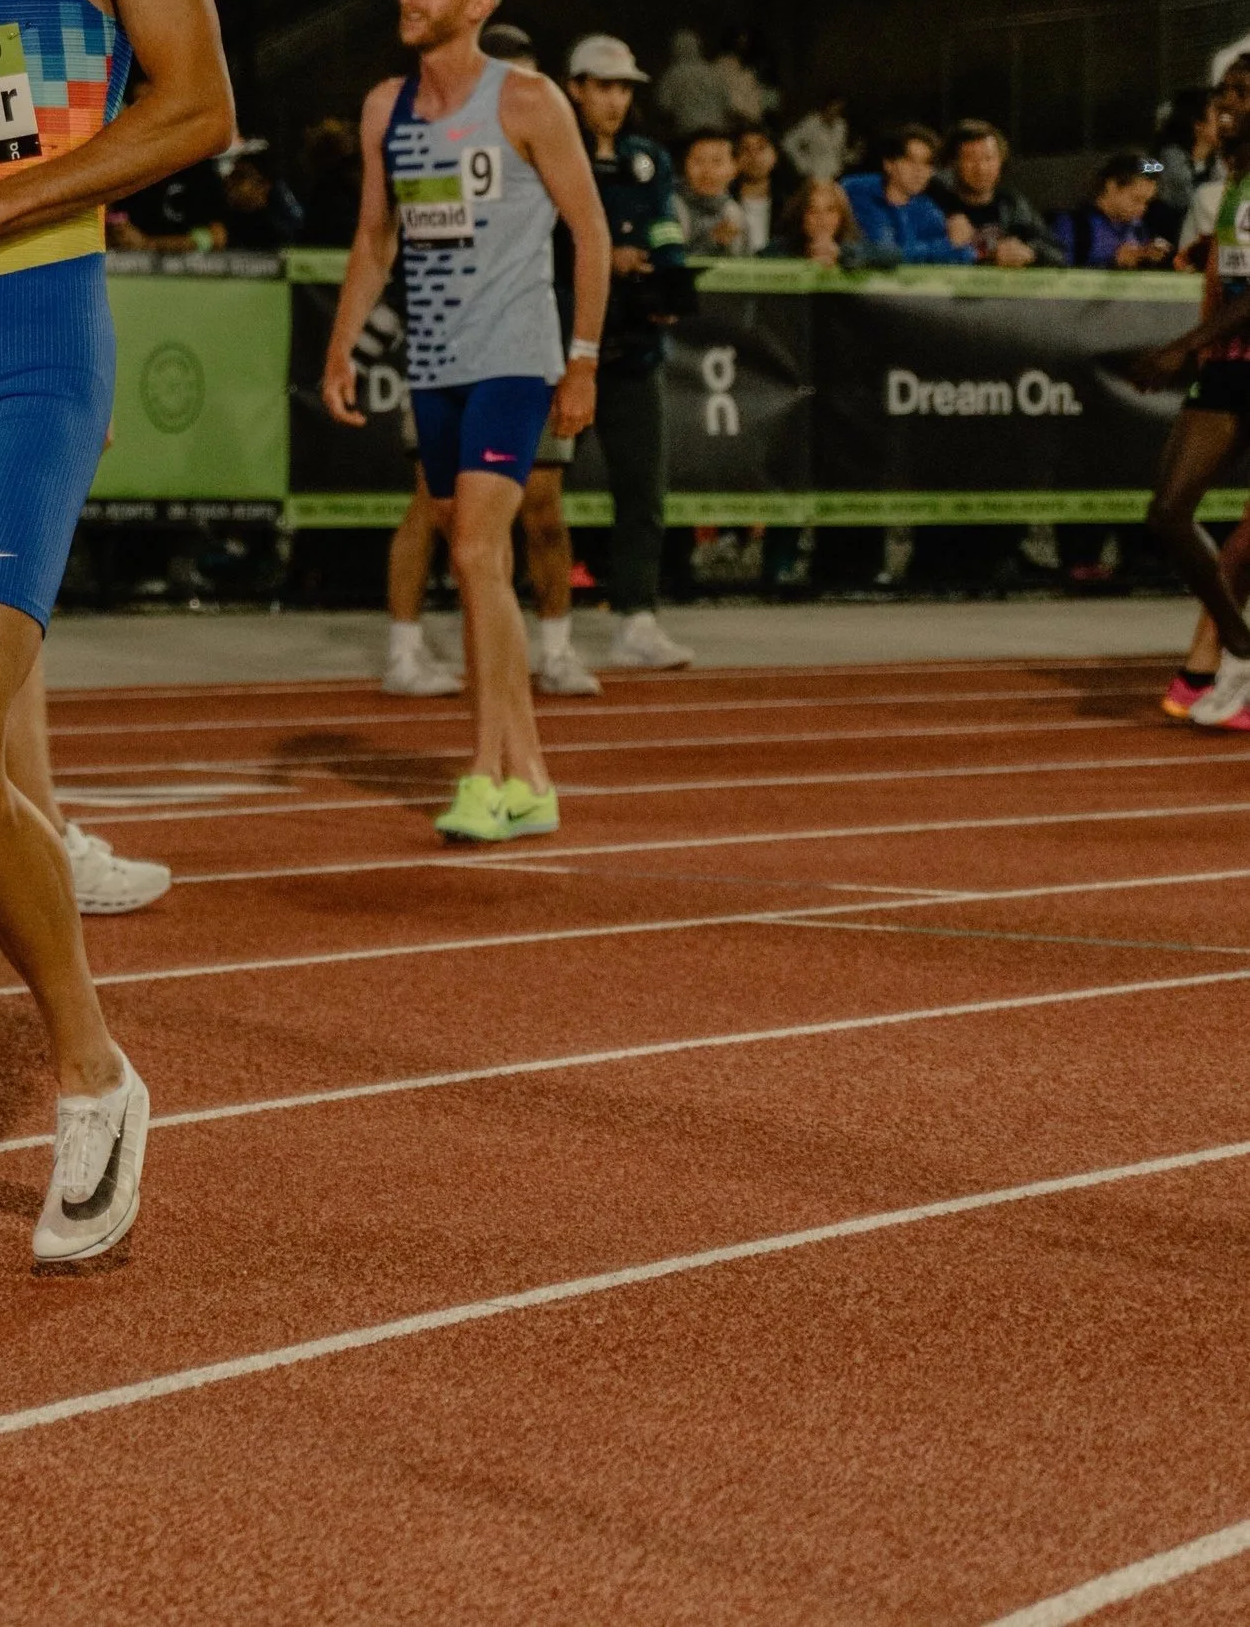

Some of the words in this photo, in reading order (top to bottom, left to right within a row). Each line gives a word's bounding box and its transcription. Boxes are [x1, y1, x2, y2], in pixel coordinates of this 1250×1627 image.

[470, 151, 493, 197] 9
[887, 370, 1010, 416] Dream
[1017, 370, 1083, 416] On.
